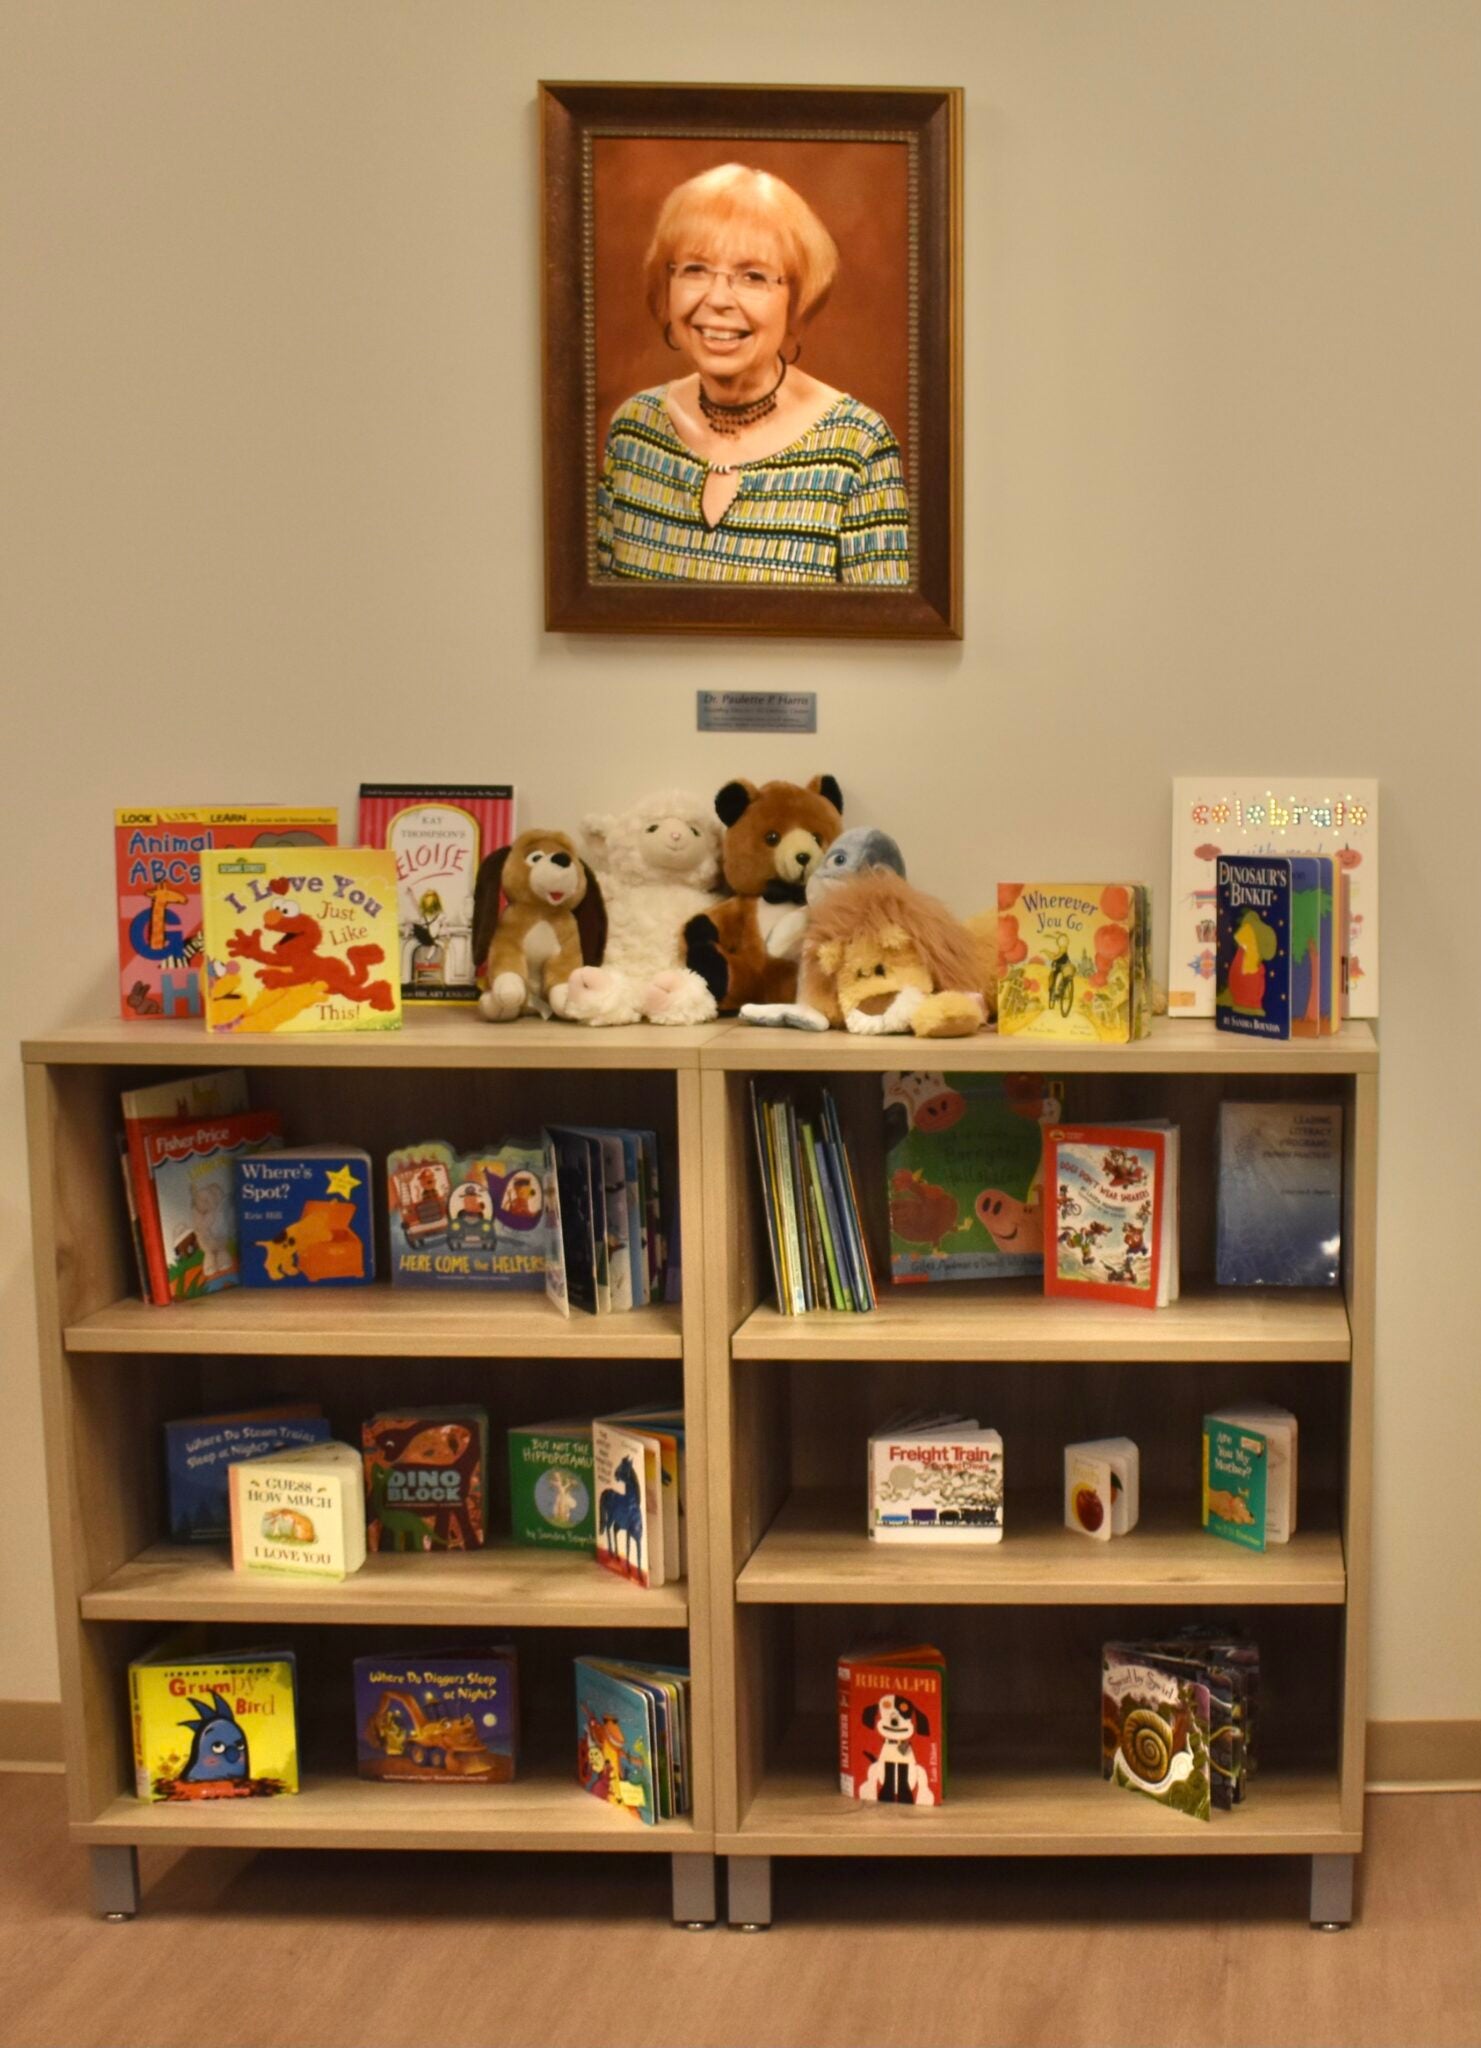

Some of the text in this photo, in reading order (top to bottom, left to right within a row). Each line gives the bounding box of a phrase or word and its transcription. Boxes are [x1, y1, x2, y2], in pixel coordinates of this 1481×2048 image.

[121, 813, 153, 823] LOOK
[210, 813, 247, 823] LEARN
[421, 815, 444, 825] KAY
[1192, 798, 1368, 828] celebrate
[128, 831, 213, 855] Animal
[396, 841, 470, 881] ELOISE
[129, 859, 201, 884] ABCs
[1219, 861, 1288, 887] DINOSAUR'S
[225, 893, 247, 914] I
[333, 874, 384, 919] You
[1022, 890, 1099, 917] Wherever
[1231, 883, 1274, 906] BINKIT
[316, 900, 356, 921] Just
[1036, 911, 1084, 934] You Go
[329, 925, 368, 946] Like
[316, 1004, 361, 1021] This!
[241, 1163, 313, 1180] Where's
[241, 1183, 291, 1202] Spot?
[400, 1254, 432, 1273] HERE
[434, 1254, 471, 1274] COME
[185, 1434, 222, 1454] Where
[223, 1429, 240, 1441] Do
[242, 1426, 278, 1439] Steam
[531, 1438, 550, 1451] BUT
[552, 1440, 571, 1452] NOT
[523, 1447, 594, 1469] HIPPOPOTAMU
[889, 1446, 990, 1466] Freight Train
[265, 1478, 312, 1492] GUESS
[388, 1470, 461, 1488] DINO
[248, 1489, 332, 1509] HOW MUCH
[387, 1488, 461, 1501] BLOCK
[264, 1547, 301, 1562] LOVE
[302, 1551, 332, 1565] YOU
[169, 1676, 255, 1696] Grumpy
[369, 1671, 497, 1688] Where Do Diggers Sleep
[855, 1673, 937, 1694] RRRALPH
[457, 1686, 497, 1702] Night?
[235, 1694, 276, 1716] Bird
